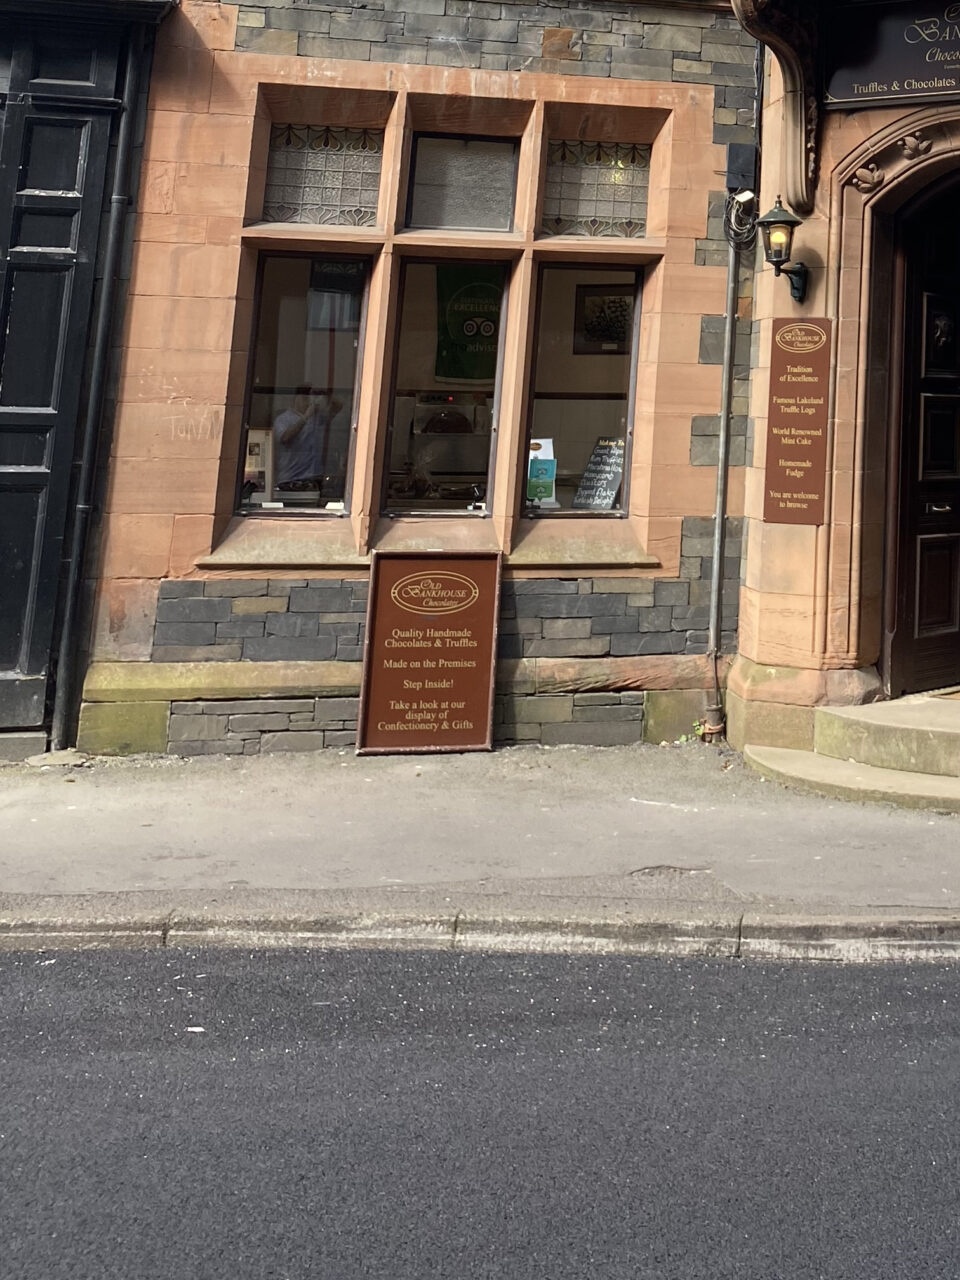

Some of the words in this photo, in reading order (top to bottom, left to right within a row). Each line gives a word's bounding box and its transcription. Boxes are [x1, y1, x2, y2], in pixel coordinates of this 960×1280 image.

[853, 82, 887, 94] Truffles
[891, 81, 900, 91] &
[904, 77, 955, 89] Chocolates
[773, 396, 795, 404] Famous
[797, 396, 824, 404] Lakeland
[801, 406, 816, 415] Logs
[772, 427, 790, 435] World
[791, 427, 822, 436] Renowned
[796, 437, 812, 445] Cake
[786, 469, 804, 478] Fudge
[769, 490, 781, 498] You
[793, 491, 819, 500] welcome
[402, 585, 467, 598] BANKHOUSE
[392, 628, 424, 639] Quality
[426, 628, 472, 638] Handmade
[384, 638, 432, 648] Chocolates
[434, 638, 442, 648] &
[445, 638, 478, 647] Truffles
[383, 659, 408, 668] Made
[423, 659, 436, 668] the
[439, 658, 477, 668] Premises
[403, 680, 422, 691] Step
[425, 679, 454, 689] Inside!
[390, 700, 410, 710] Take
[412, 702, 418, 710] a
[419, 700, 438, 709] look
[441, 701, 449, 709] at
[450, 701, 466, 709] our
[405, 711, 436, 721] display
[438, 710, 449, 719] of
[377, 721, 439, 732] Confectionery
[441, 721, 449, 730] &
[452, 720, 474, 730] Gifts
